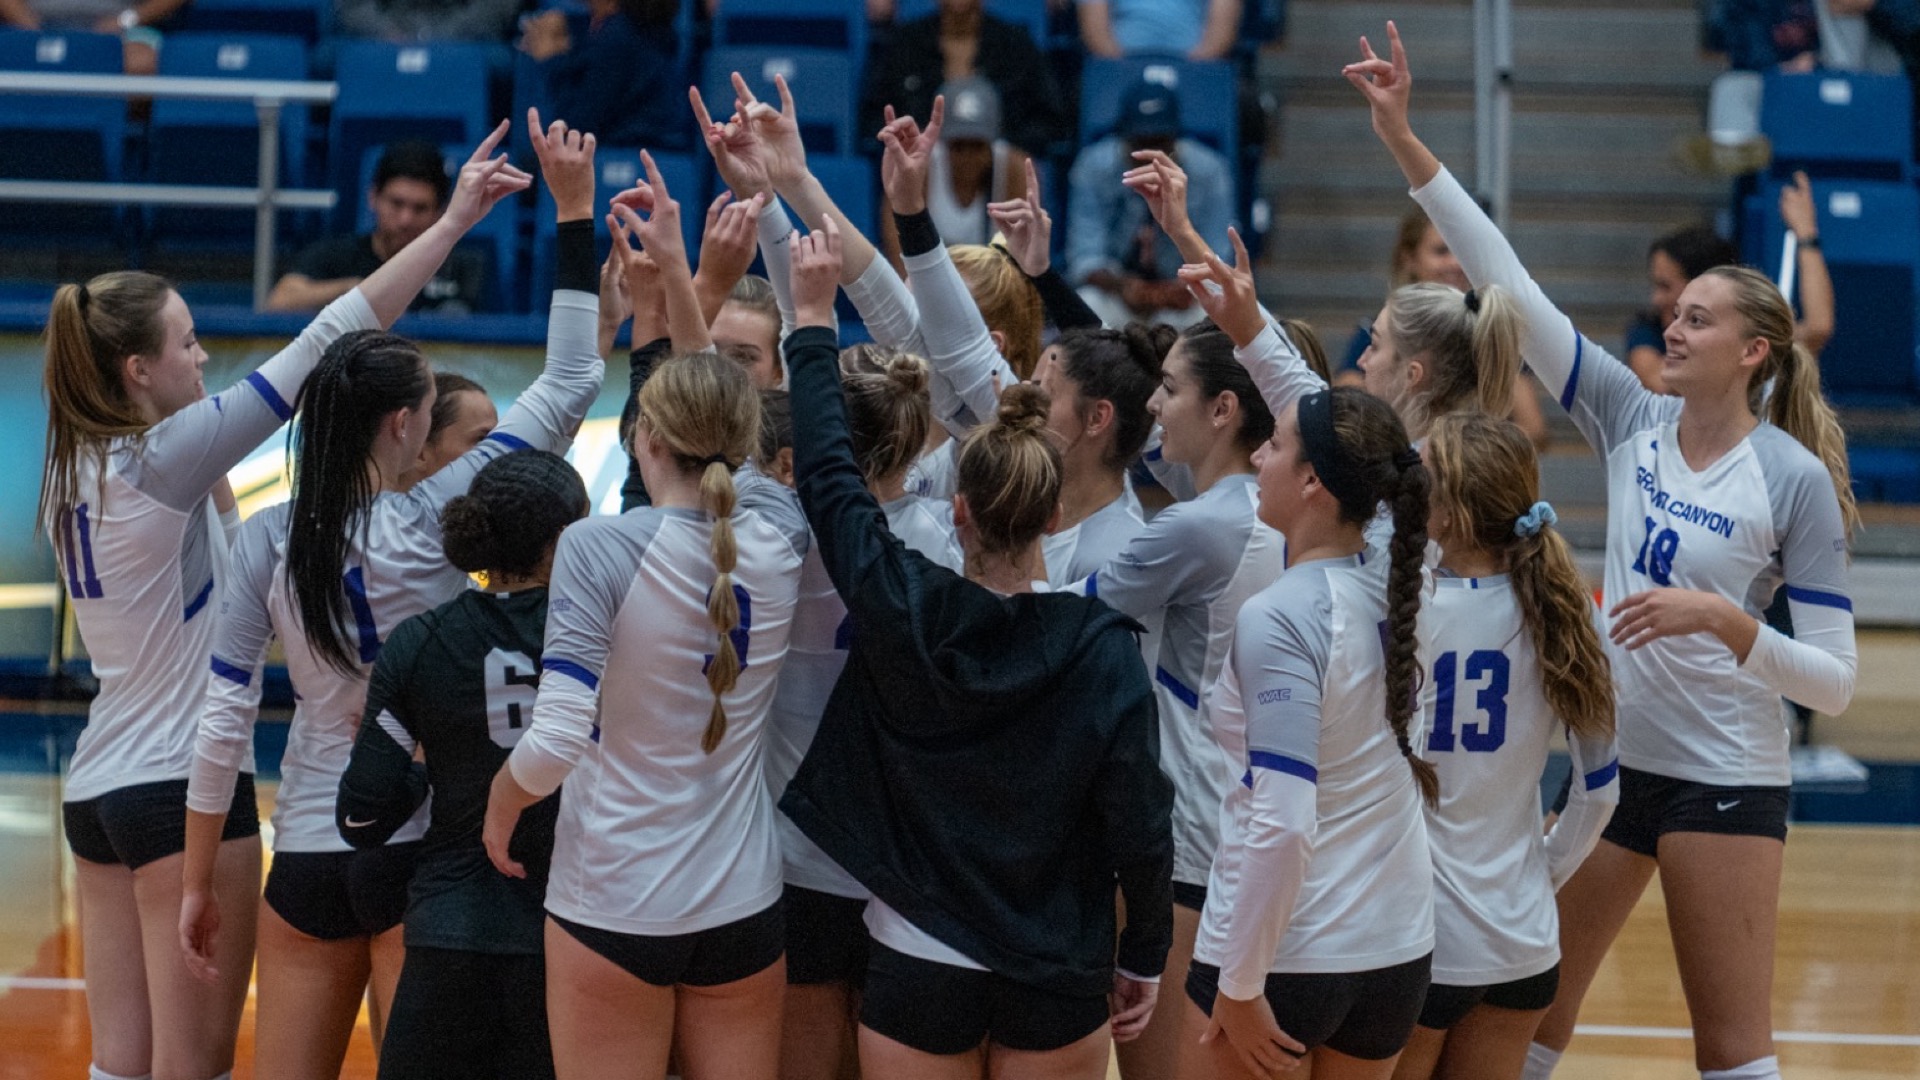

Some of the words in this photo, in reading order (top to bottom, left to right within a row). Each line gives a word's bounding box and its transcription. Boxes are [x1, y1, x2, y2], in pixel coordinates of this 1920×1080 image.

[62, 502, 104, 599] 11
[1632, 516, 1680, 587] 18
[1668, 500, 1735, 539] CANYON
[484, 647, 538, 749] 6
[1257, 688, 1291, 705] WAC
[1427, 649, 1510, 752] 13
